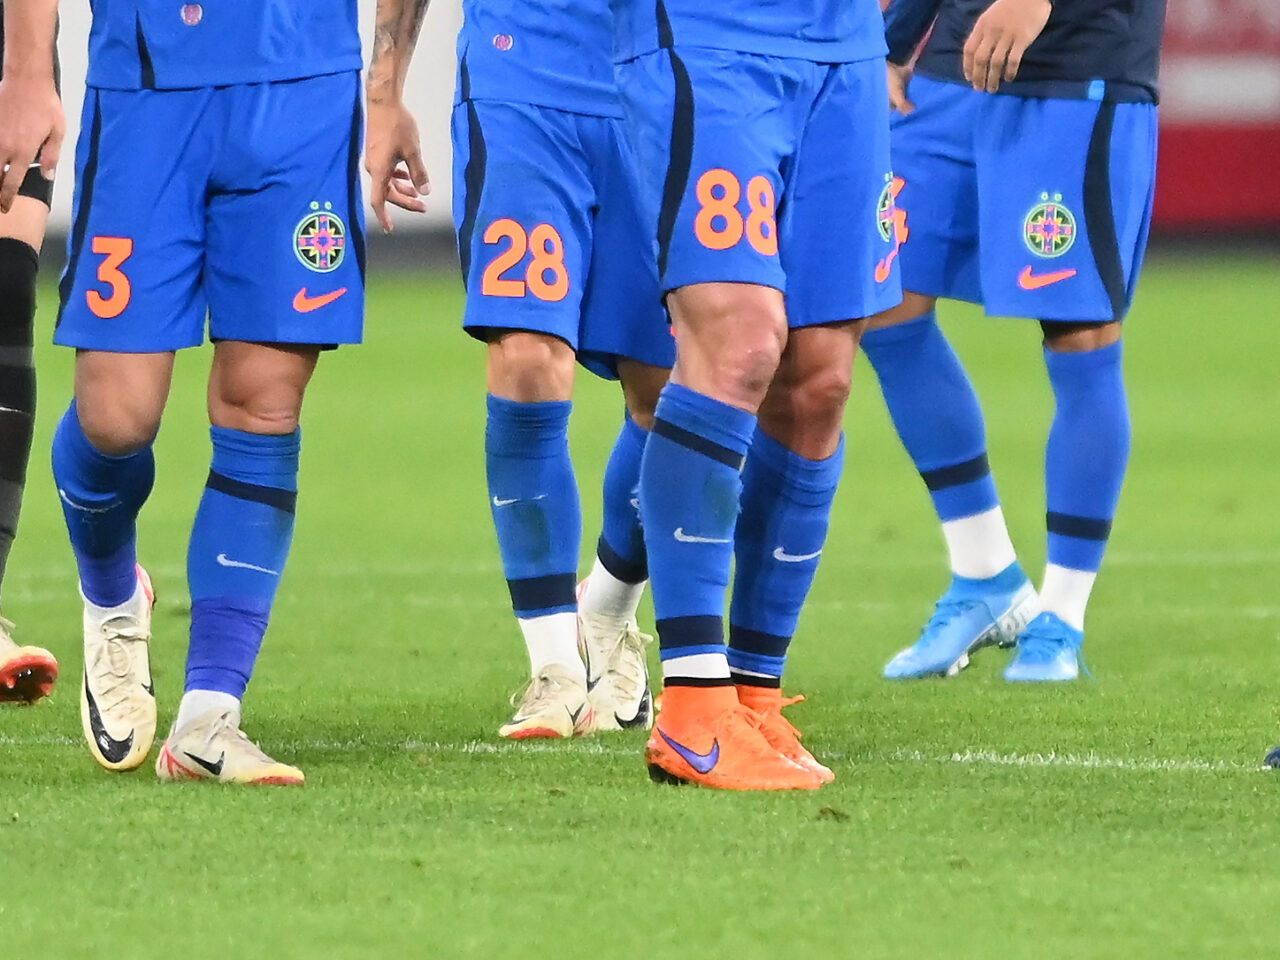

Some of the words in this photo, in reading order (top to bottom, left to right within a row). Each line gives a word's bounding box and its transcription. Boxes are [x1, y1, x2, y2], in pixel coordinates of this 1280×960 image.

[694, 168, 779, 257] 88
[85, 236, 134, 320] 3
[481, 218, 570, 302] 28
